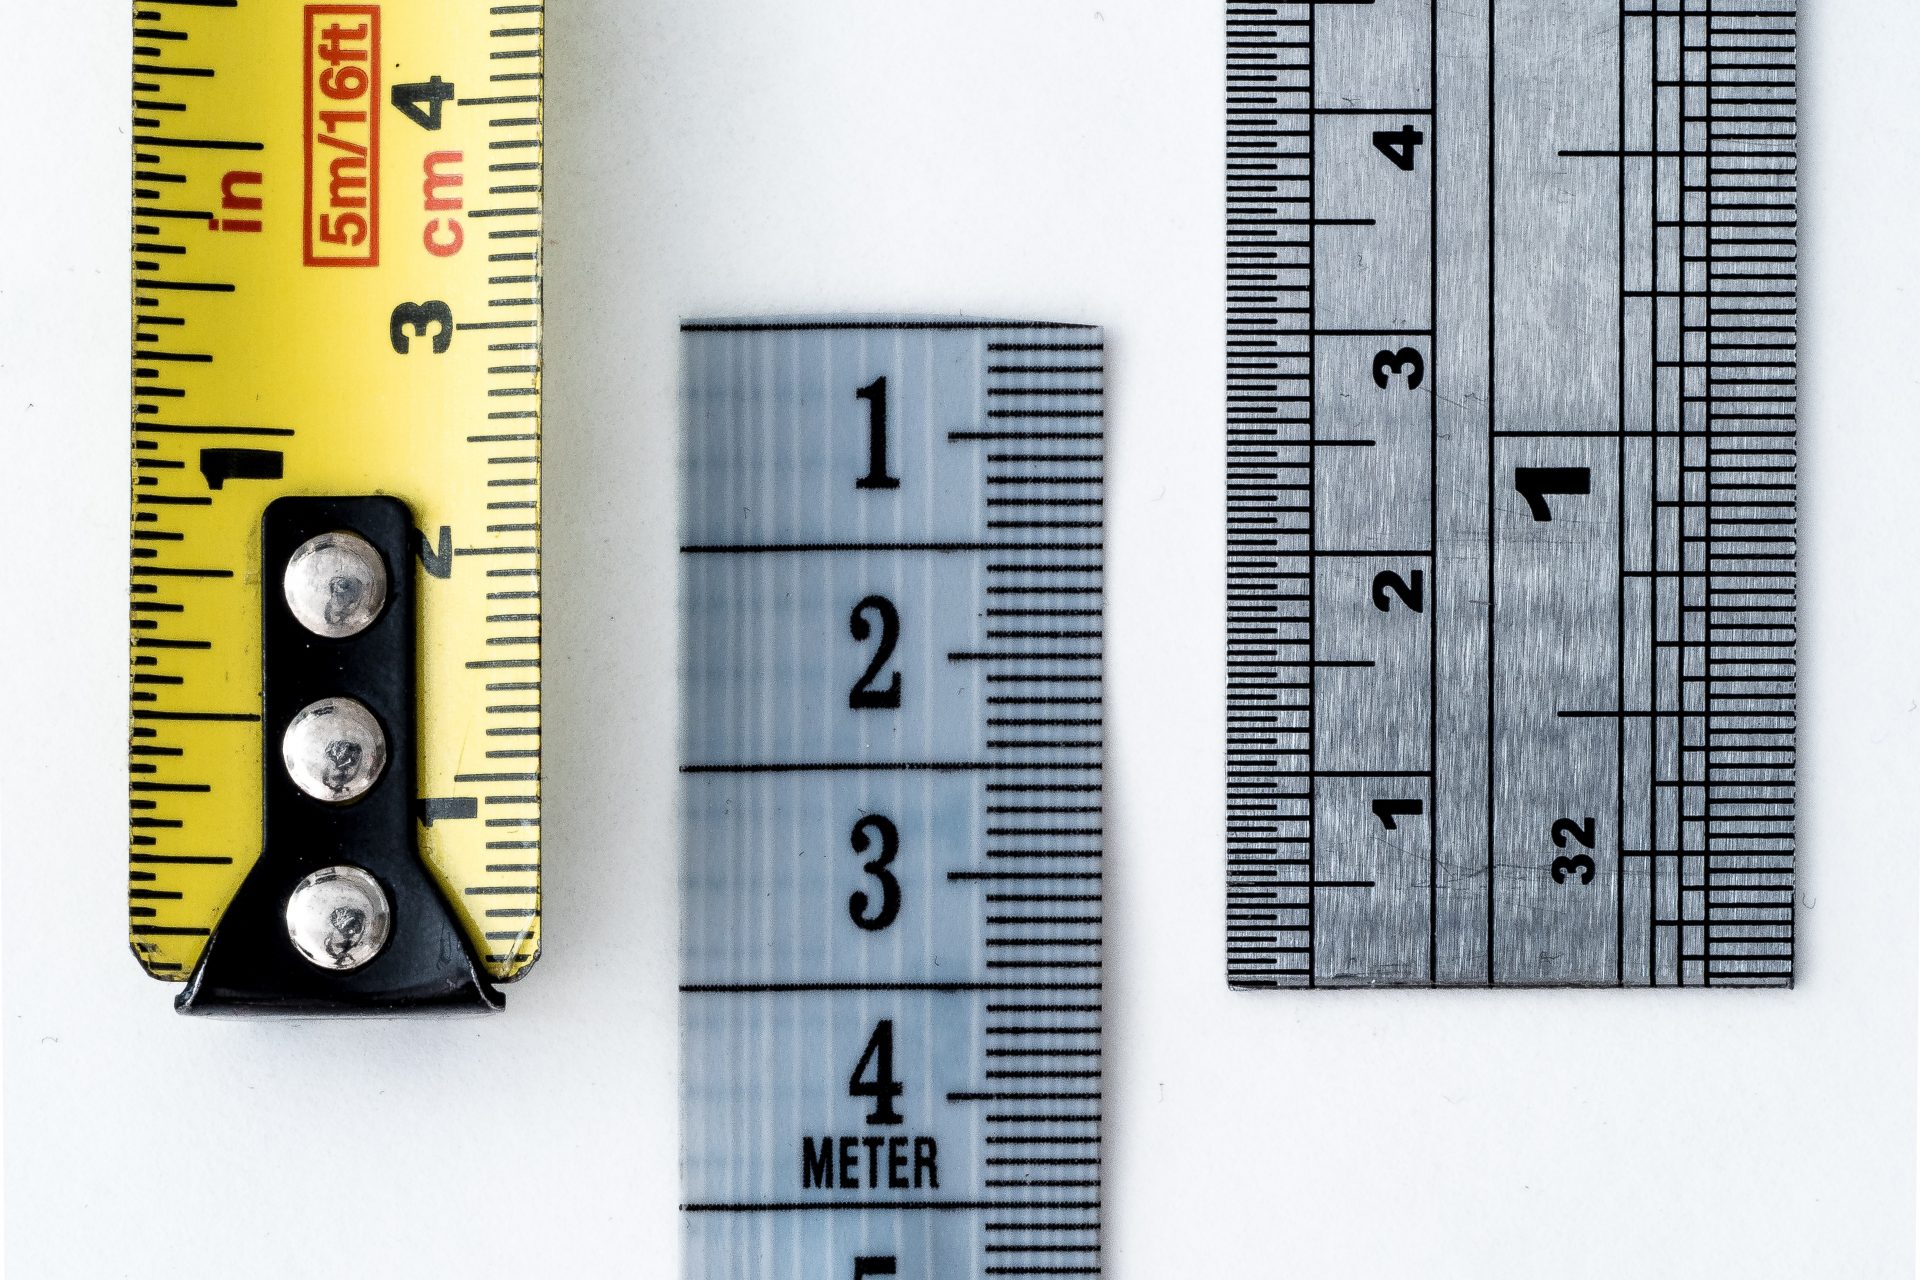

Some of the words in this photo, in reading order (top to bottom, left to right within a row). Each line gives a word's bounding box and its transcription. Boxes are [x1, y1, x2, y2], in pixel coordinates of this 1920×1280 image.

[391, 75, 455, 131] 4
[317, 23, 369, 247] 5m/16ft
[1372, 124, 1424, 171] 4
[208, 171, 263, 233] in
[423, 150, 464, 257] cm
[390, 300, 453, 354] 3
[1372, 346, 1424, 391] 3
[855, 376, 899, 490] 1
[200, 448, 284, 490] 1
[1515, 467, 1591, 522] 1
[1372, 569, 1424, 613] 2
[849, 594, 902, 710] 2
[1371, 798, 1423, 831] 1
[849, 814, 901, 932] 3
[1551, 817, 1595, 886] 32
[849, 1020, 904, 1125] 4
[802, 1136, 940, 1189] METER
